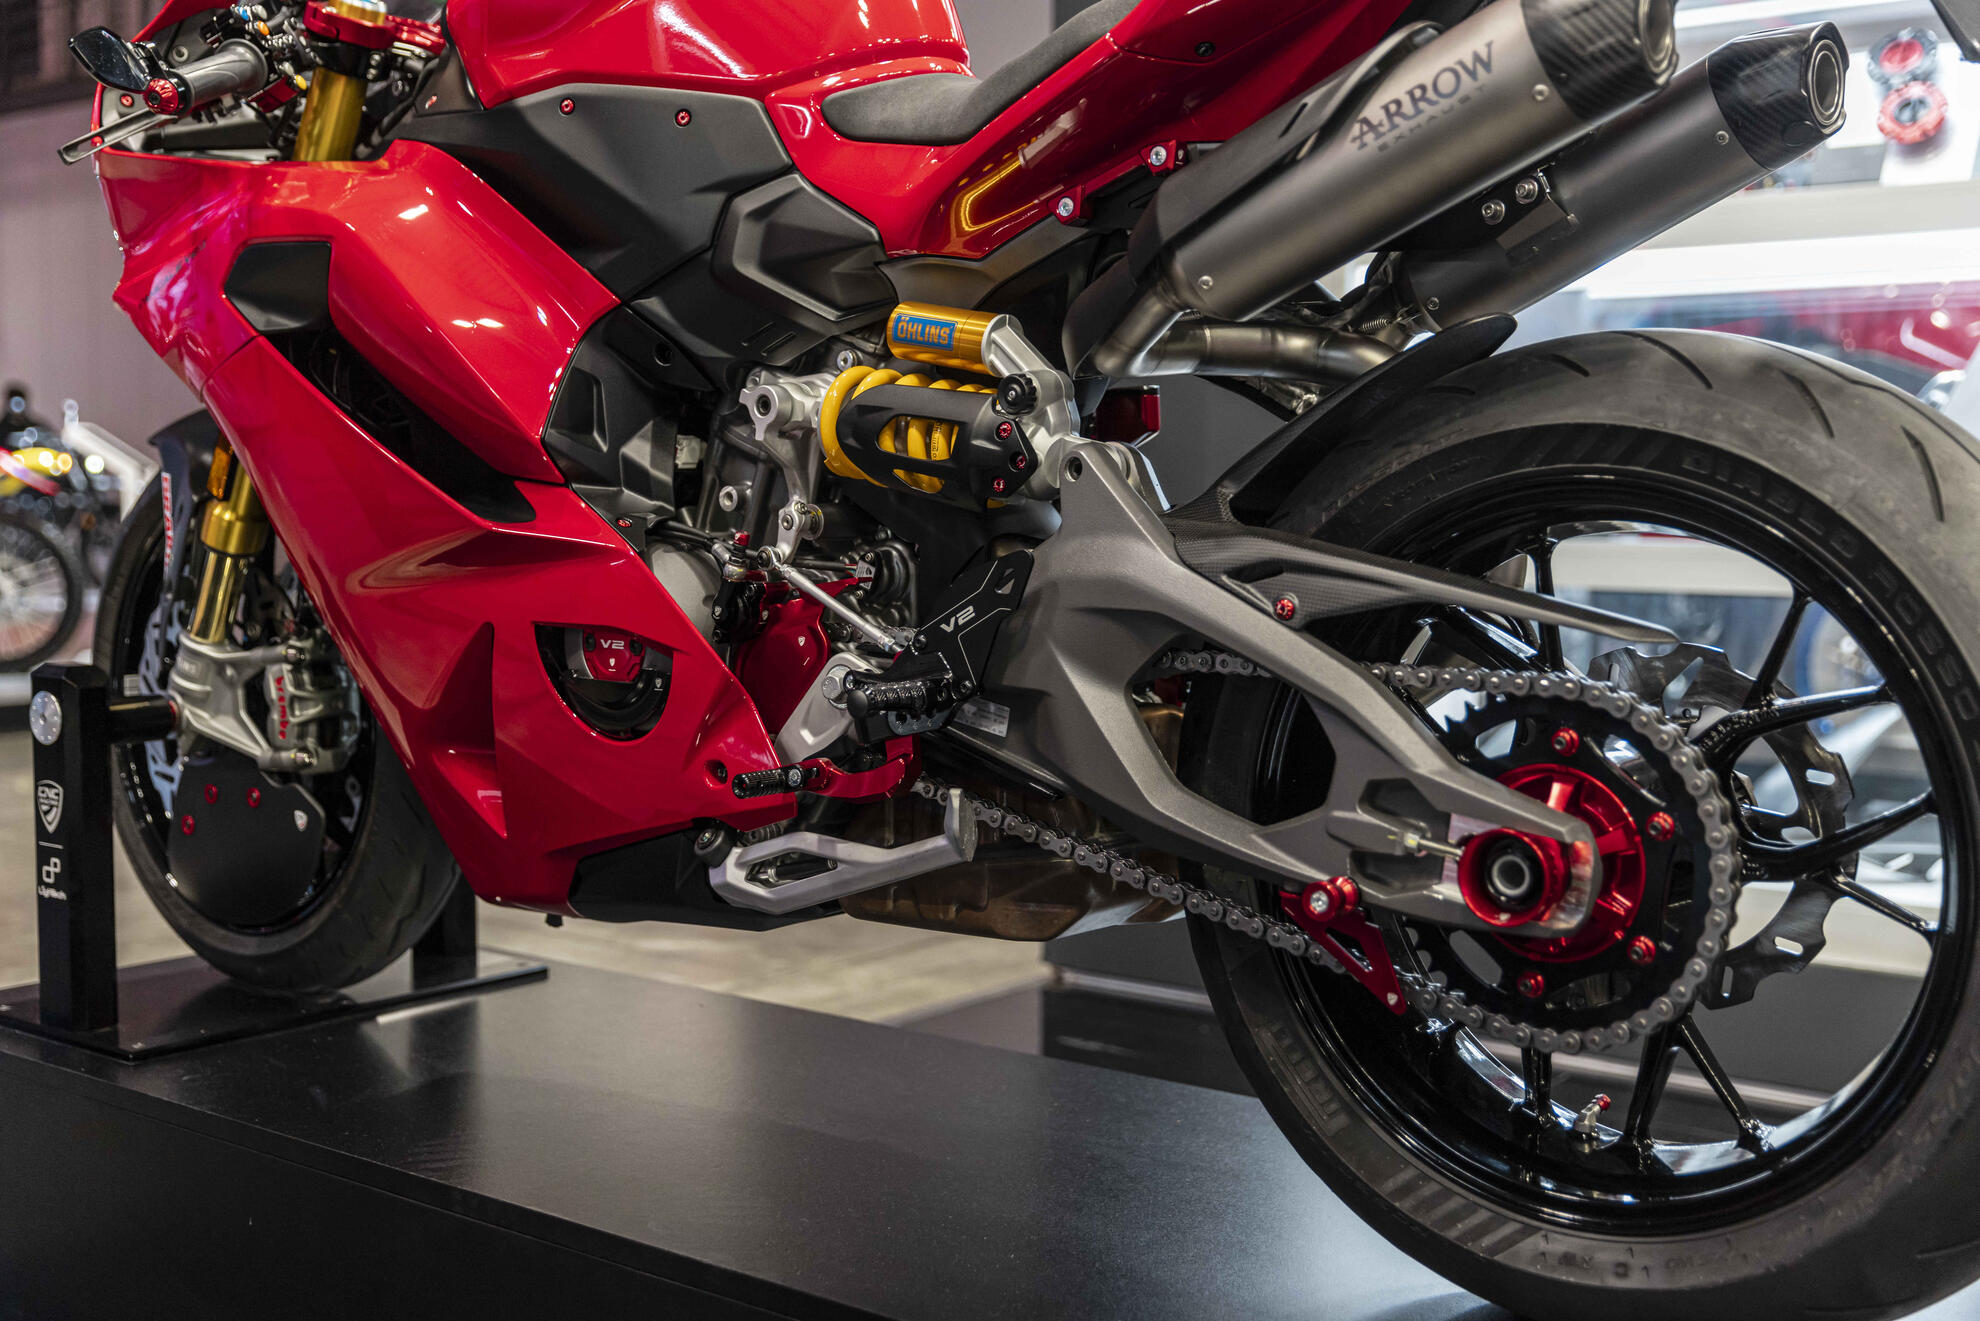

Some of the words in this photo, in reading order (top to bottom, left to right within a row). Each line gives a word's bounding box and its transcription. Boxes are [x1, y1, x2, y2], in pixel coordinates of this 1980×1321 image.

[1351, 40, 1494, 151] ARROW
[897, 316, 950, 345] ÖHLINS
[940, 605, 976, 633] V2
[600, 638, 625, 650] V2
